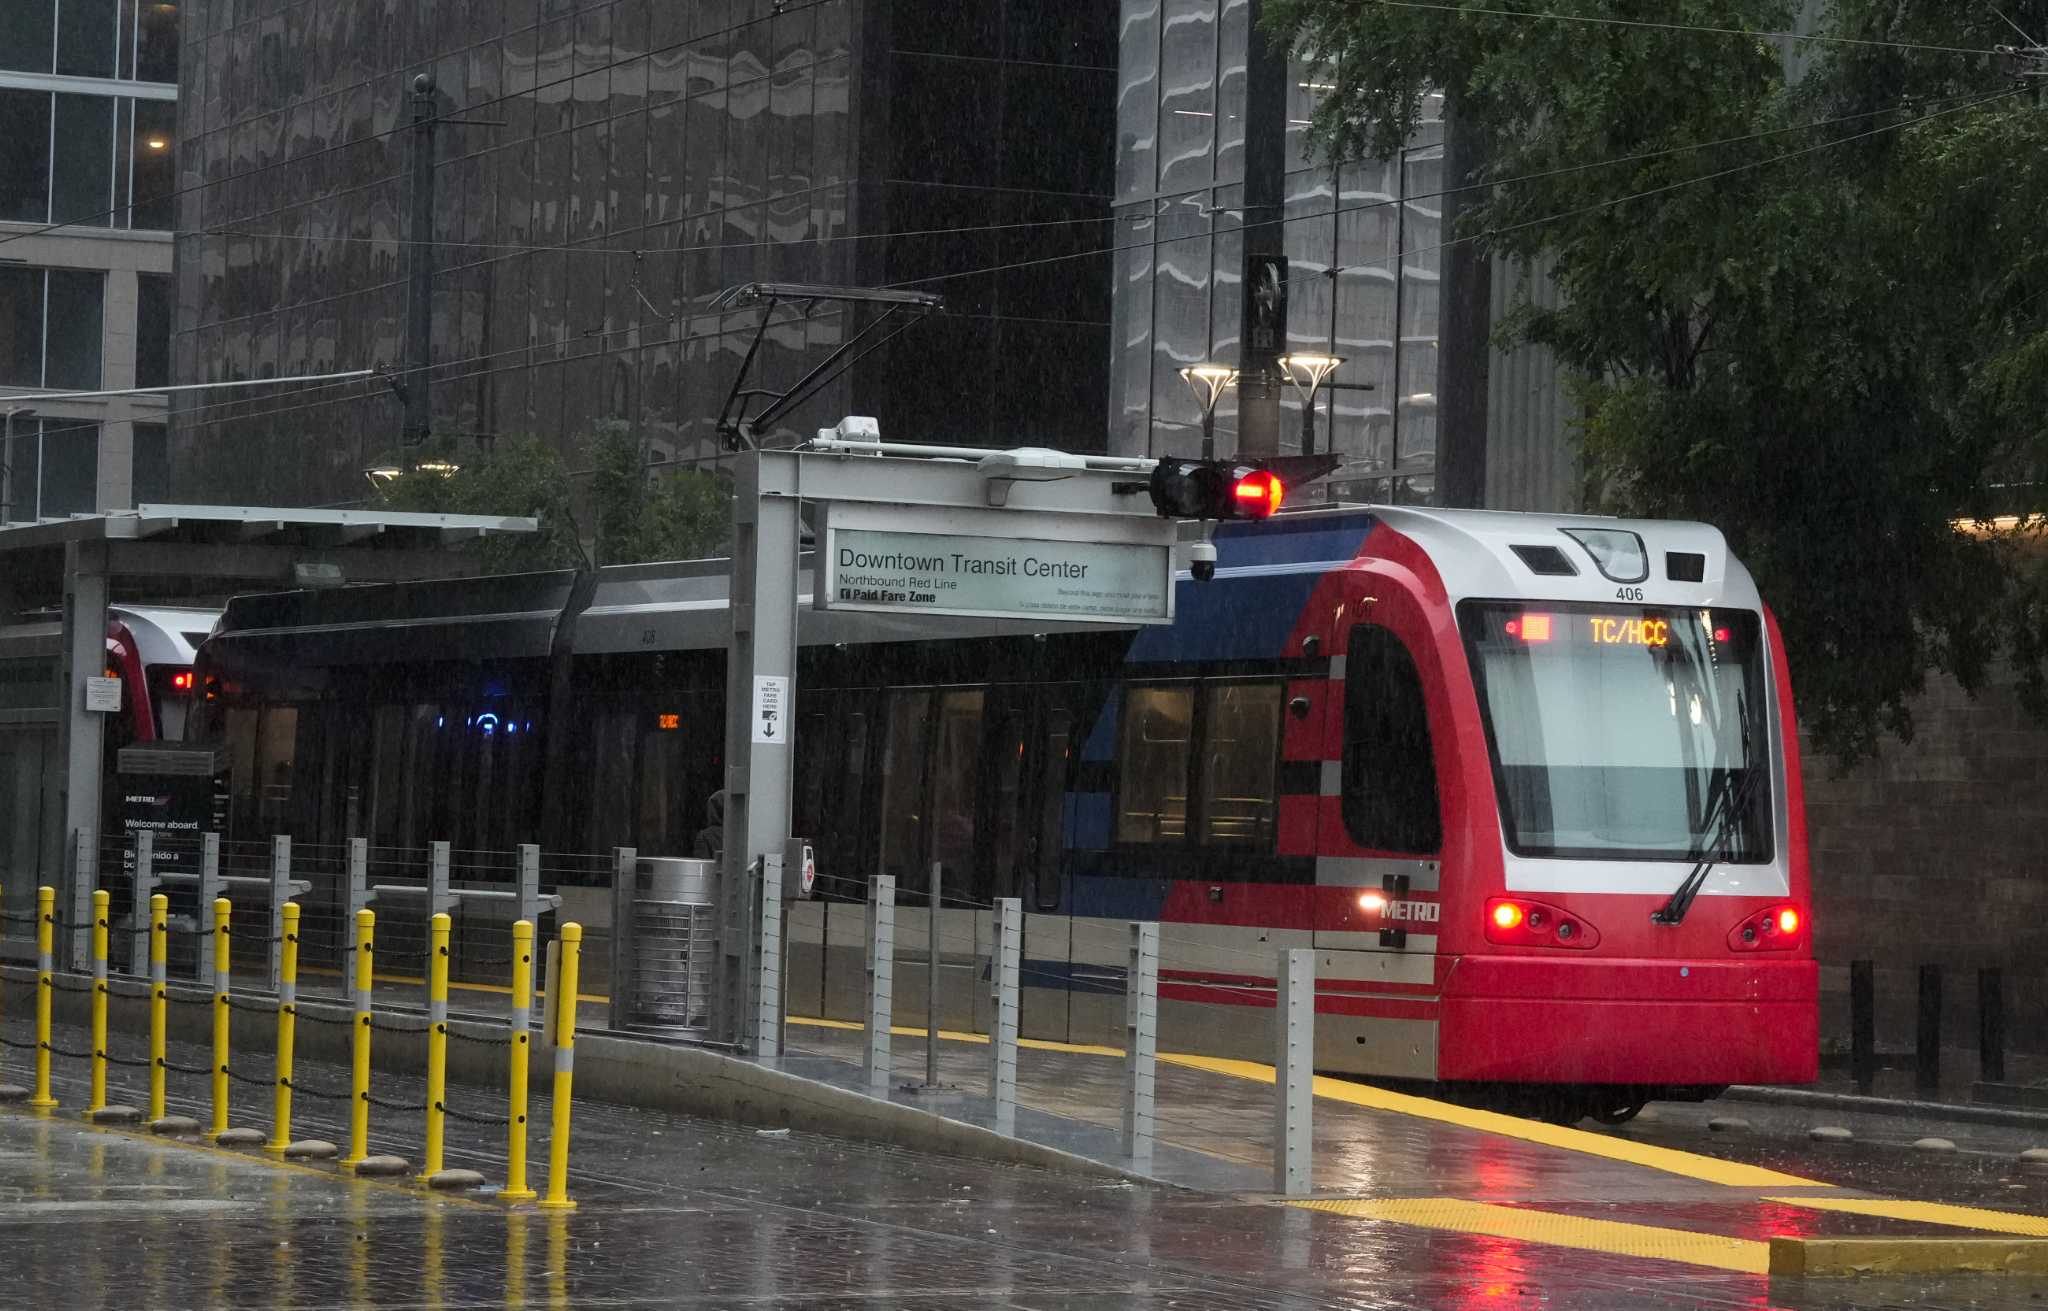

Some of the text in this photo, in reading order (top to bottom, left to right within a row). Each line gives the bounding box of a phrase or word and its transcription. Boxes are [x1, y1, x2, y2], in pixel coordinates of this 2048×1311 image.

[840, 548, 1088, 579] Downtown Transit Center
[840, 574, 957, 590] Northbound Red Line
[853, 588, 936, 603] Paid Fare Zone
[1616, 586, 1644, 602] 406
[1590, 618, 1668, 646] TC/HCC
[125, 819, 166, 829] Welcome
[1381, 900, 1440, 922] METRO
